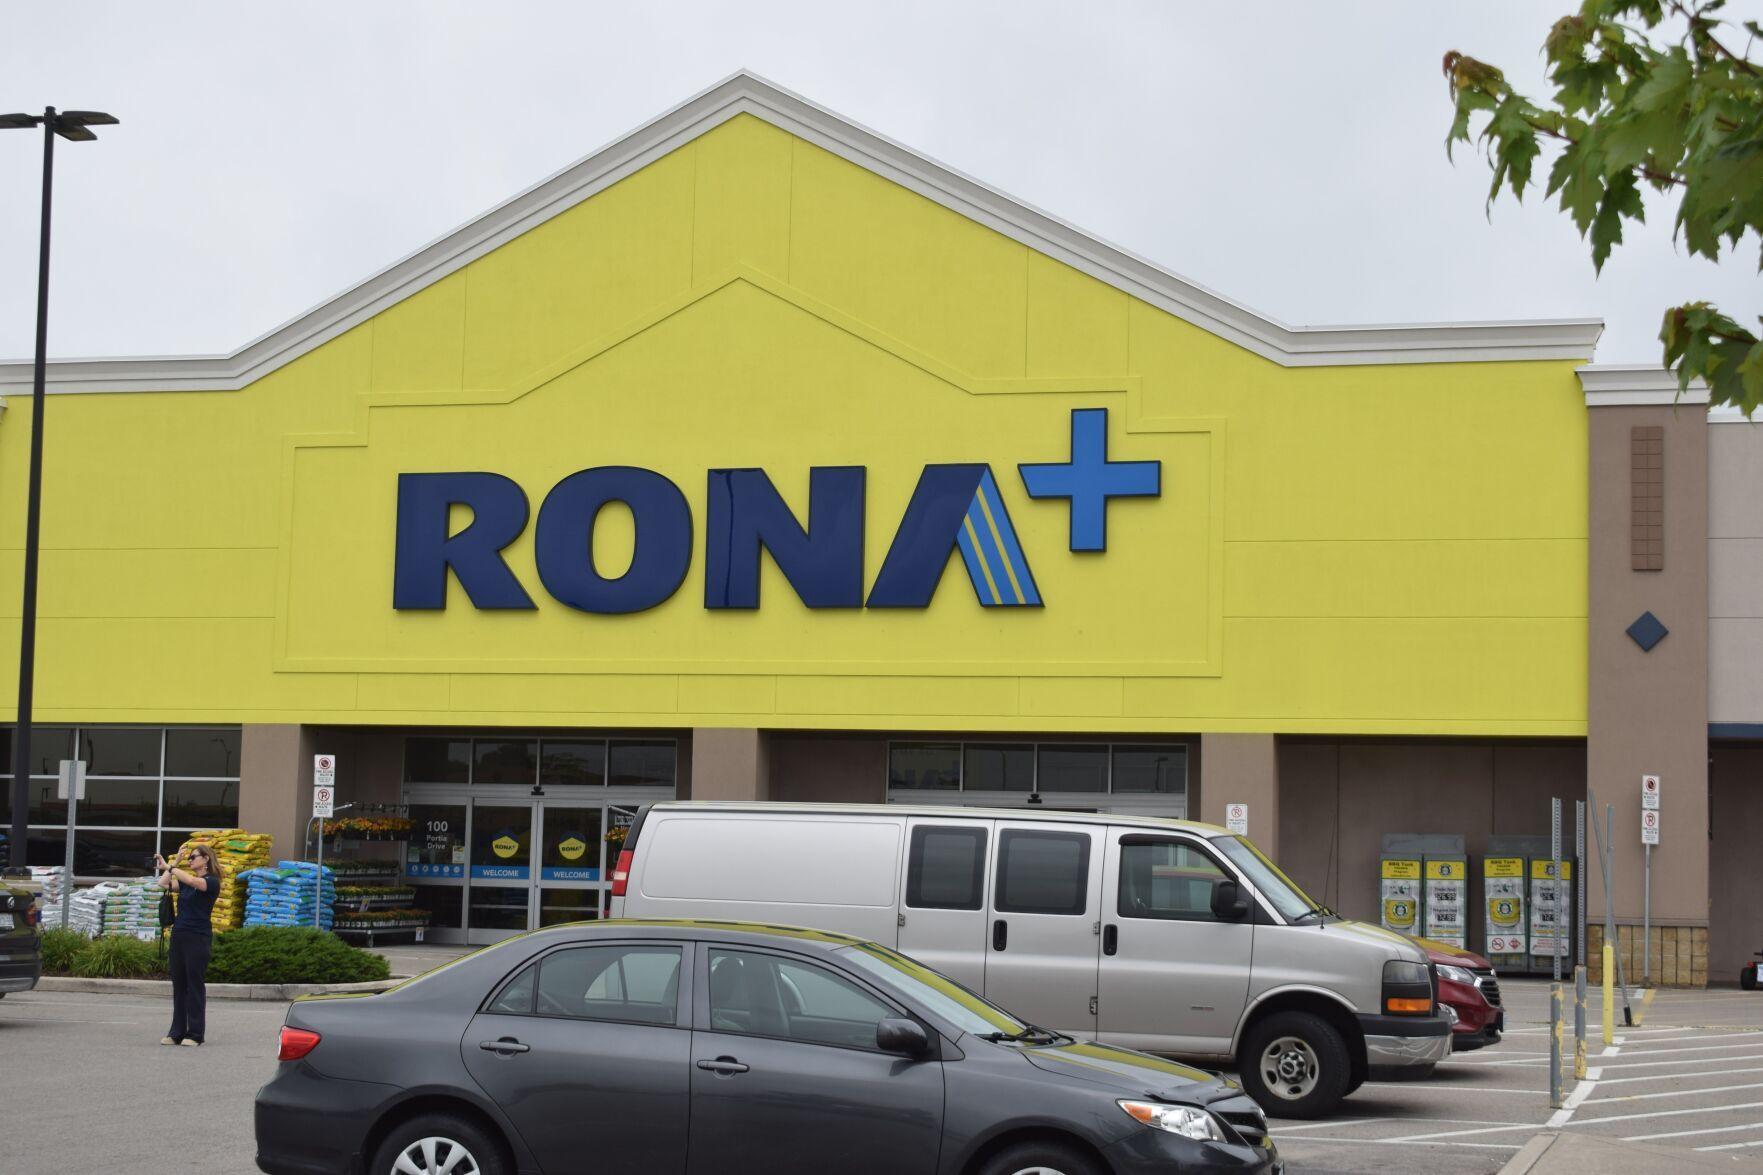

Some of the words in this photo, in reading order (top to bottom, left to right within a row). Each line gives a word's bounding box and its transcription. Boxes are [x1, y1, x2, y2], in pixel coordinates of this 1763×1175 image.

[427, 821, 448, 832] 100
[427, 842, 446, 850] Drive
[483, 869, 519, 877] WELCOME
[553, 871, 590, 879] WELCOME
